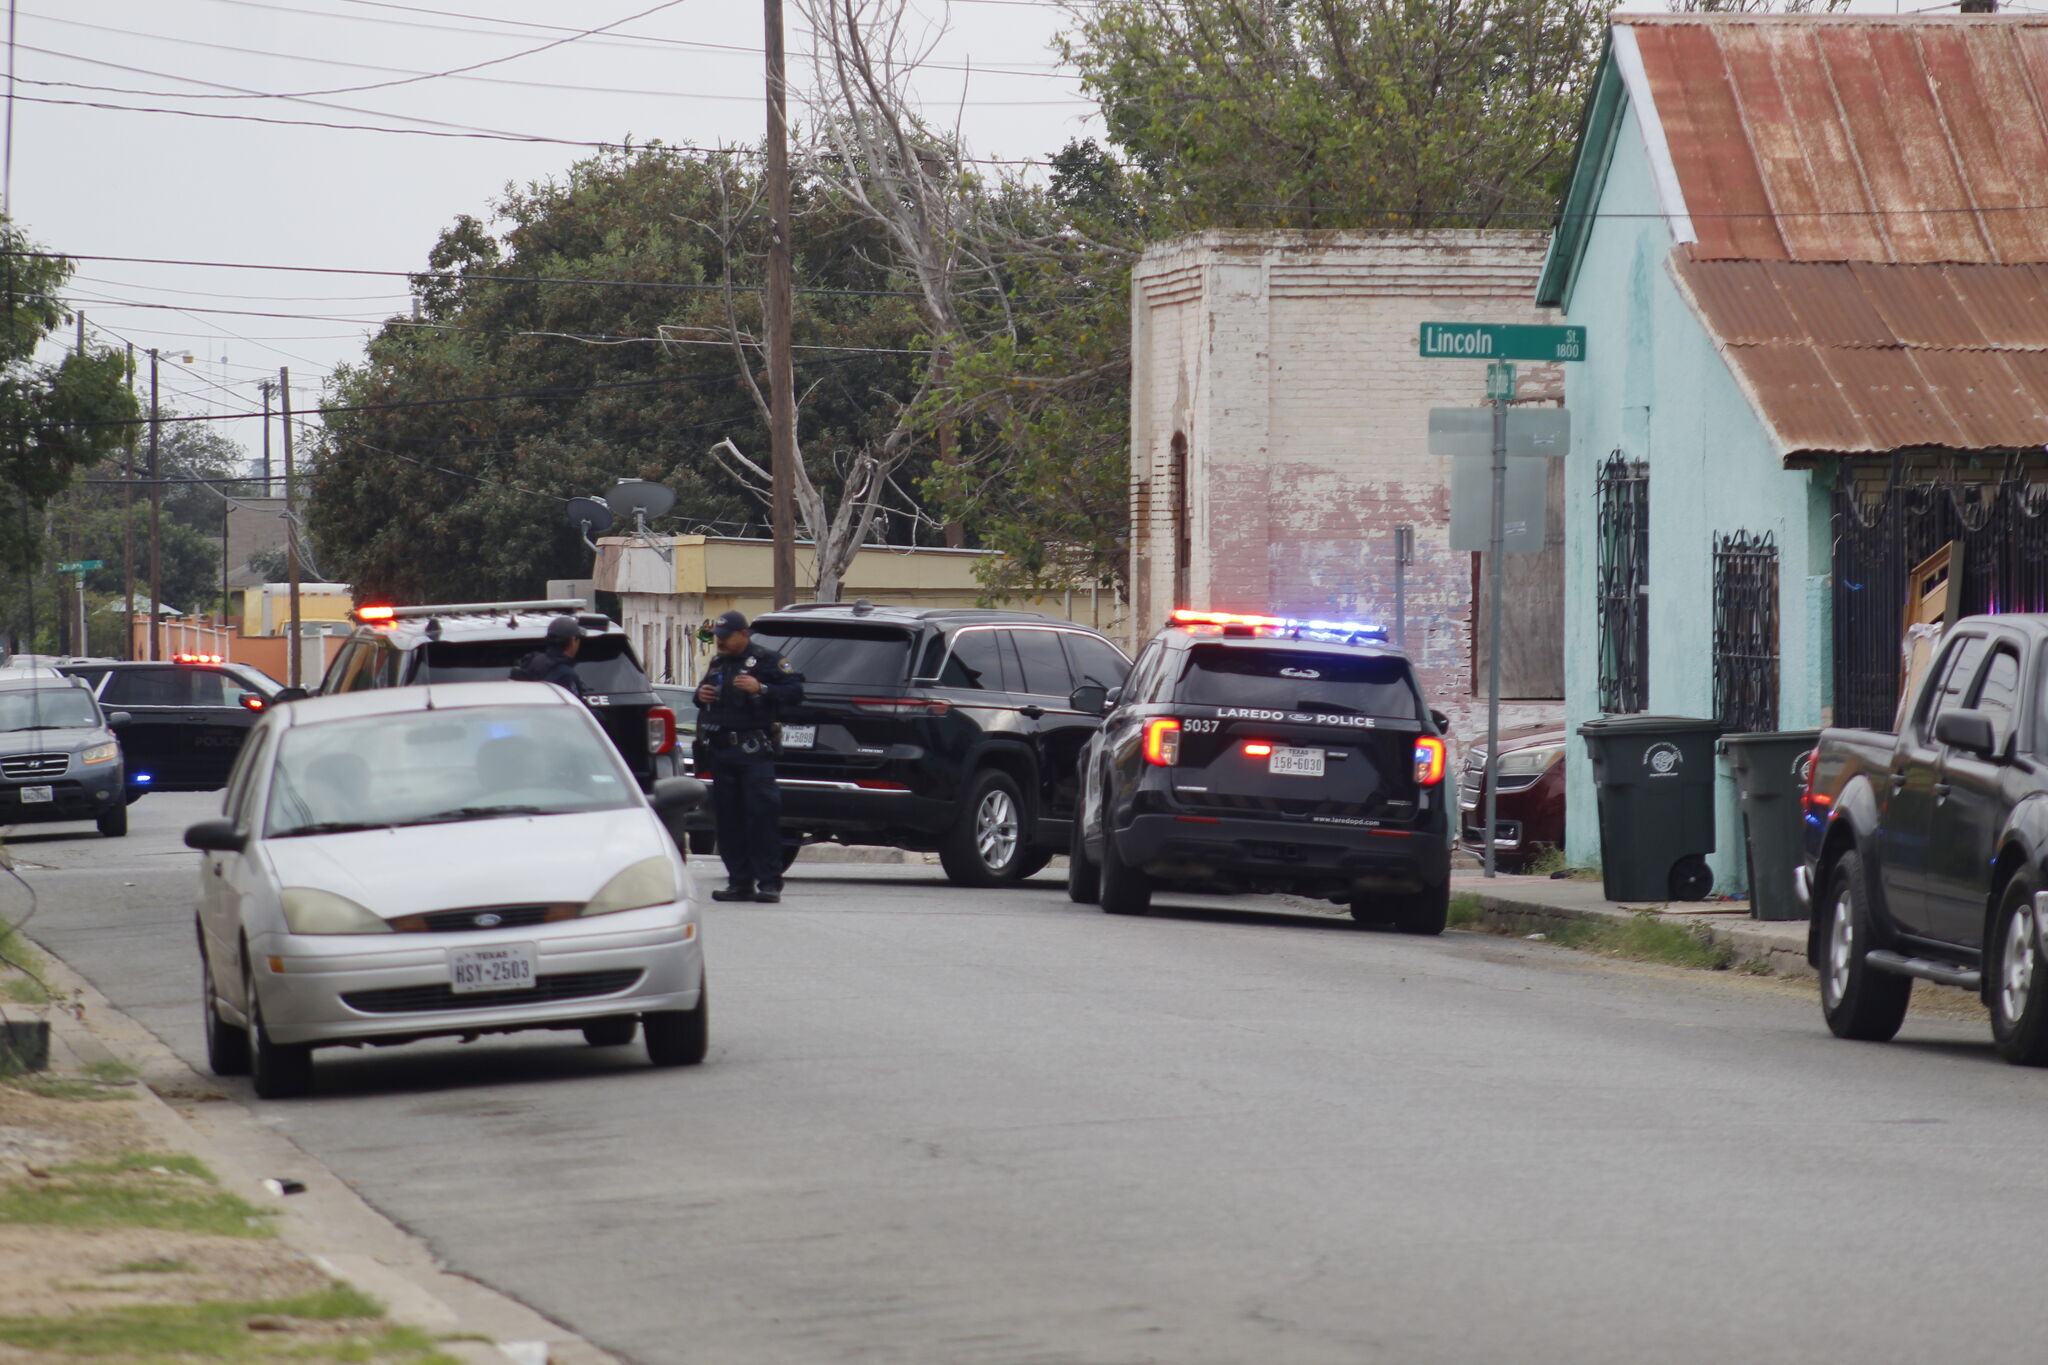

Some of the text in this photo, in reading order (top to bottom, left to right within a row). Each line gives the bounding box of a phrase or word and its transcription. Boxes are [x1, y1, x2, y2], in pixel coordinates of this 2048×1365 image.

[1427, 327, 1492, 353] Lincoln
[1566, 329, 1580, 344] St.
[1556, 344, 1579, 357] 1800
[1217, 707, 1285, 721] LAREDO
[1316, 713, 1376, 728] POLICE
[1183, 719, 1220, 733] 5037
[1288, 748, 1309, 756] TEXAS
[1274, 757, 1322, 771] 158-6030
[1313, 817, 1380, 826] www.laredopd.com
[476, 951, 508, 960] TEXAS
